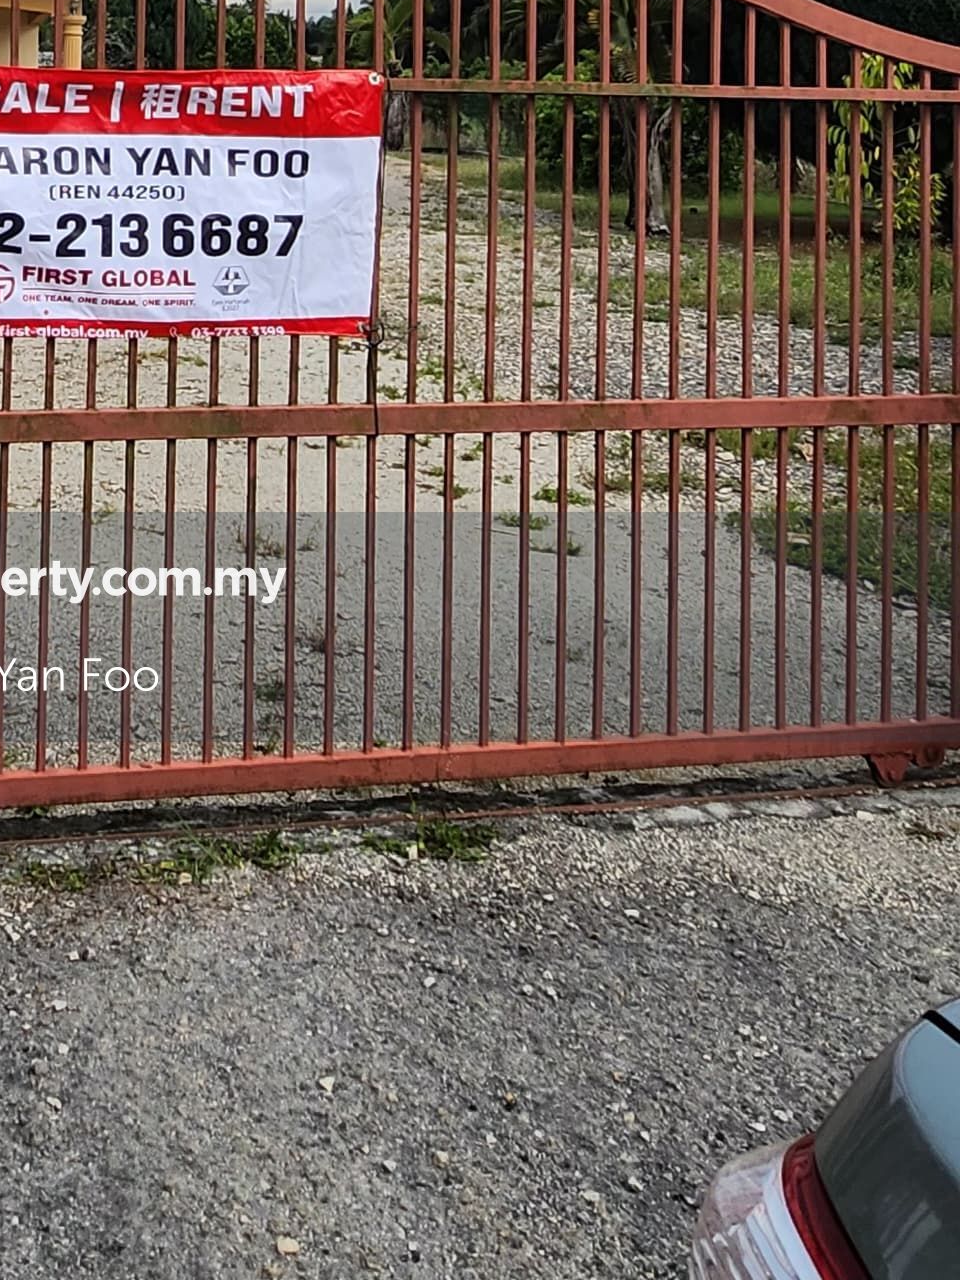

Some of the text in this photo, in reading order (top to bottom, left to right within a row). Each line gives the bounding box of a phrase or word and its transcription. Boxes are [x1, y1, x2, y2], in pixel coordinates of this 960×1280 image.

[127, 146, 211, 177] YAN
[227, 149, 310, 178] FOO
[49, 184, 185, 201] (REN 44250)
[162, 213, 304, 258] 6687
[22, 265, 197, 287] FIRST GLOBAL
[22, 294, 41, 303] ONE
[77, 296, 98, 305] ONE
[142, 298, 161, 307] ONE
